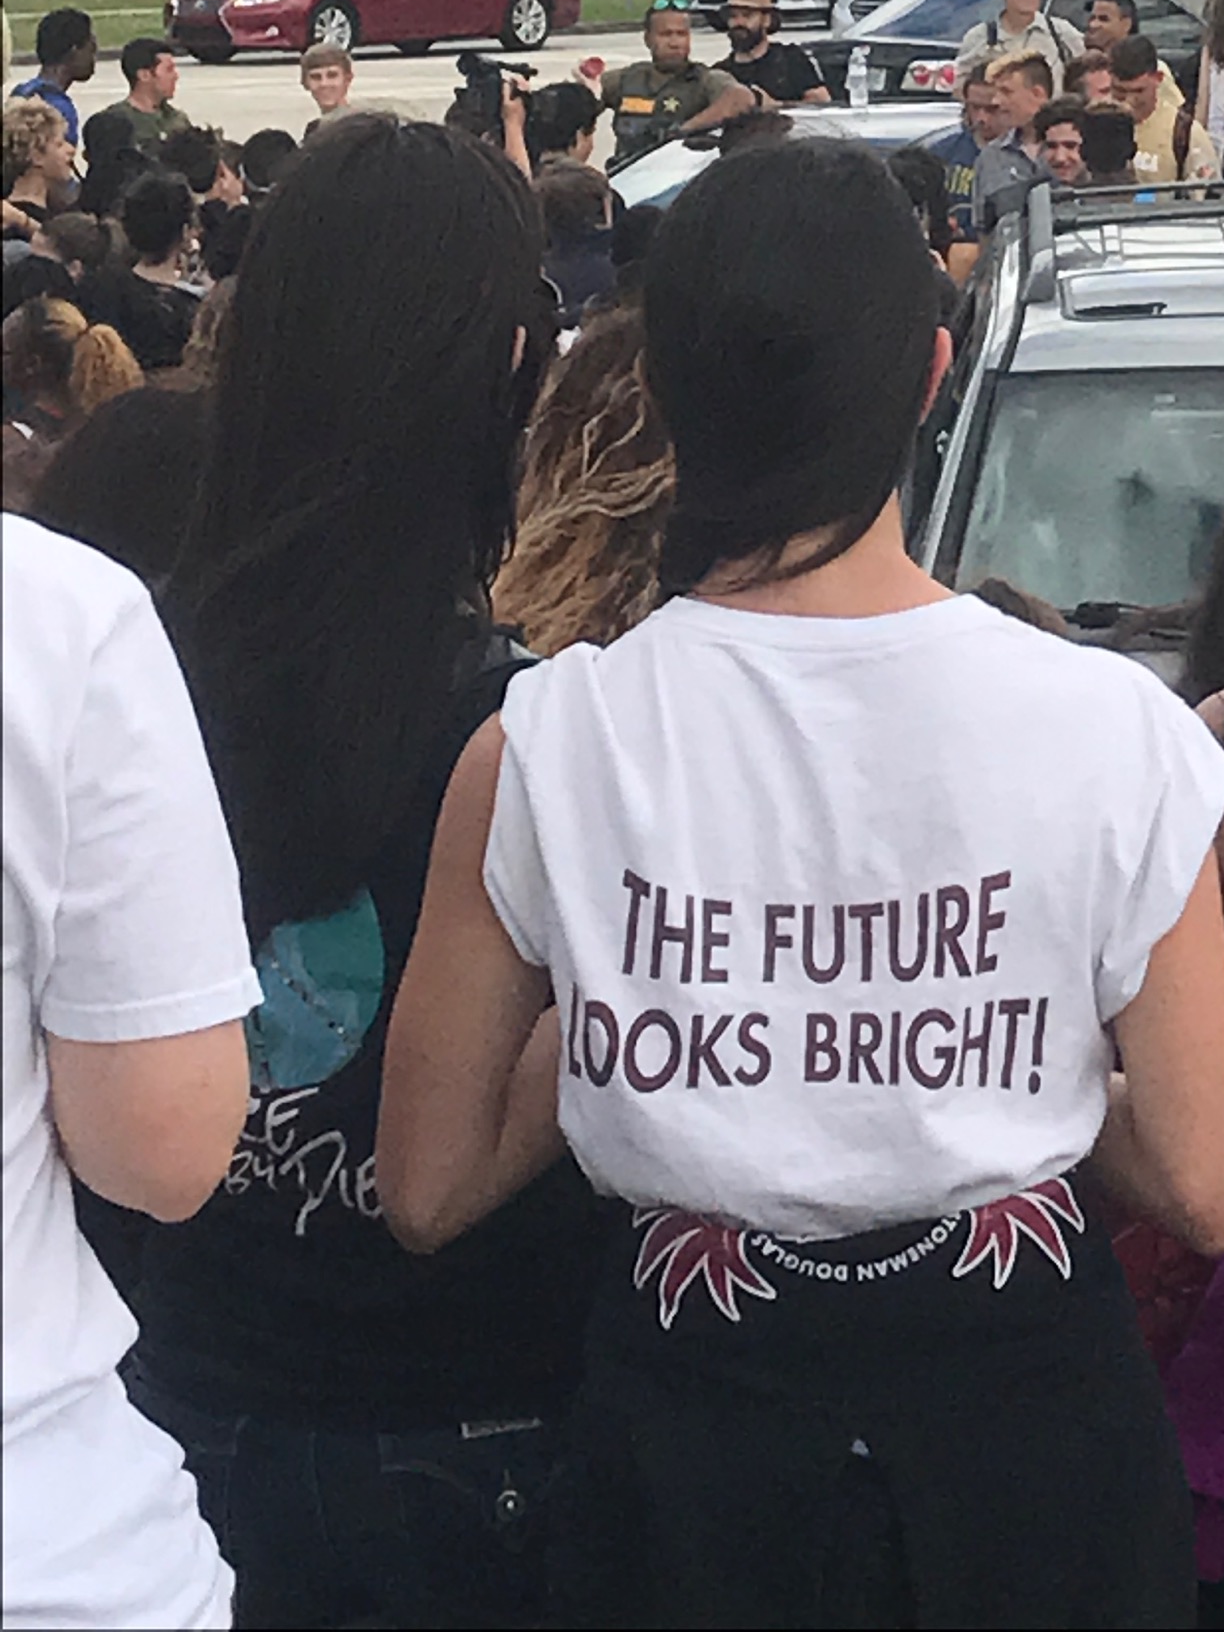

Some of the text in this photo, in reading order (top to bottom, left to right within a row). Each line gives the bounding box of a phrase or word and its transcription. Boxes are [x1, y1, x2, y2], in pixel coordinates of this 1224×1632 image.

[622, 868, 1011, 985] THE FUTURE
[567, 981, 1049, 1096] LOOKS BRIGHT!
[751, 1233, 849, 1282] DOUGLAS
